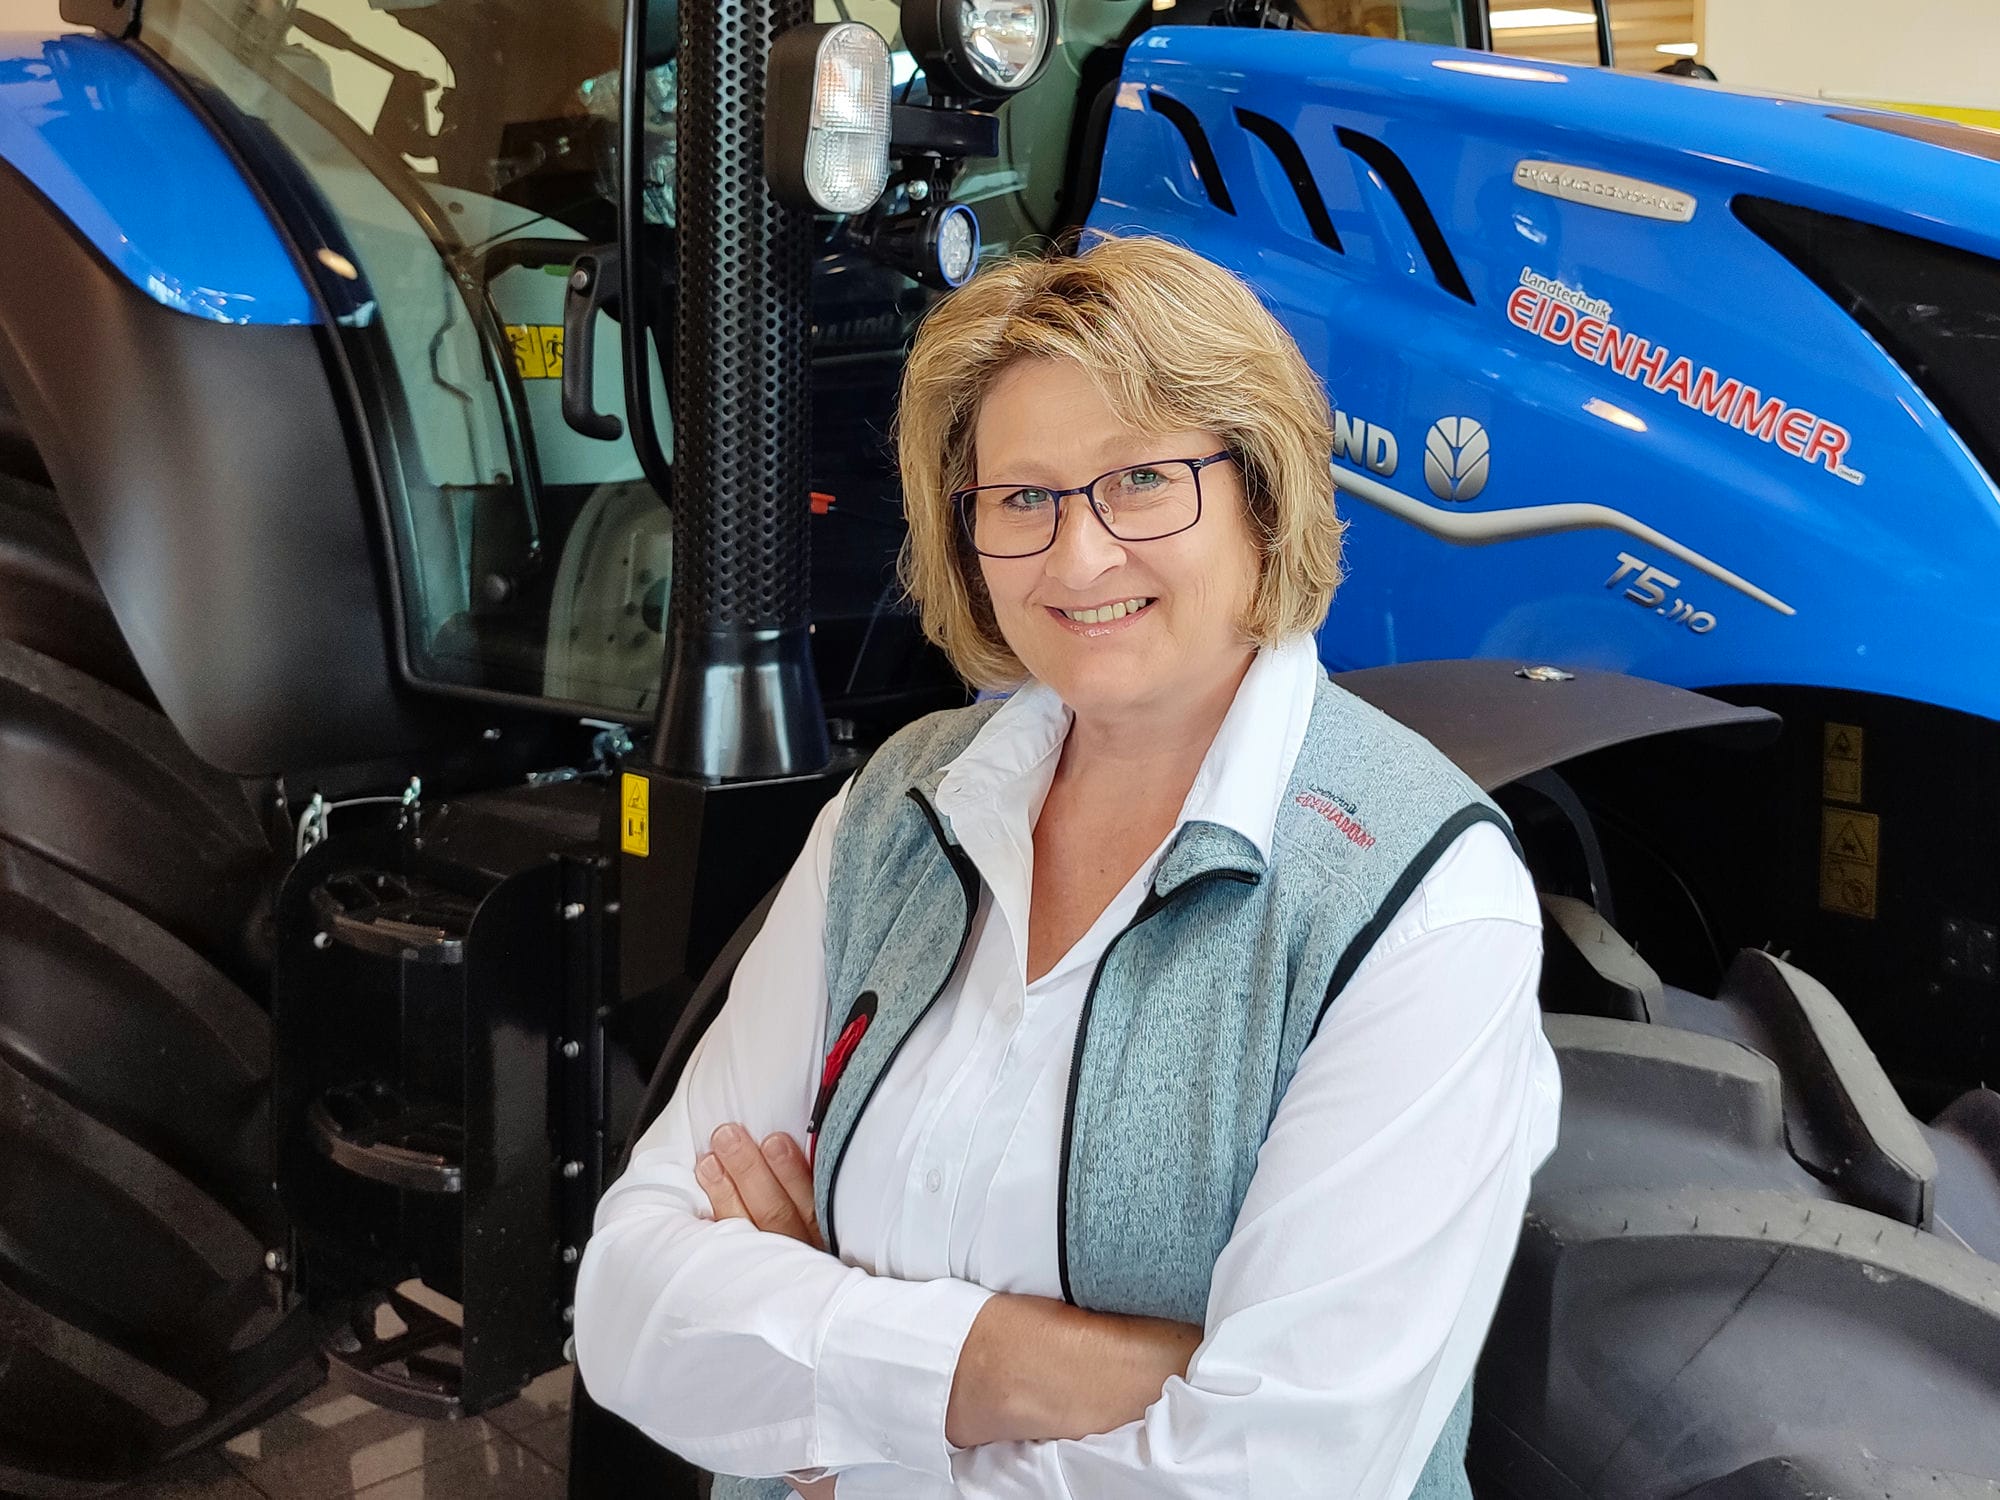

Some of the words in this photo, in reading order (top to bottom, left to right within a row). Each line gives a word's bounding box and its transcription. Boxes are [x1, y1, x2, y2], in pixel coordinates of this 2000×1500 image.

[1521, 268, 1611, 319] Landtechnik
[1508, 286, 1848, 472] EIDENHAMMER
[1604, 551, 1717, 633] T5.110
